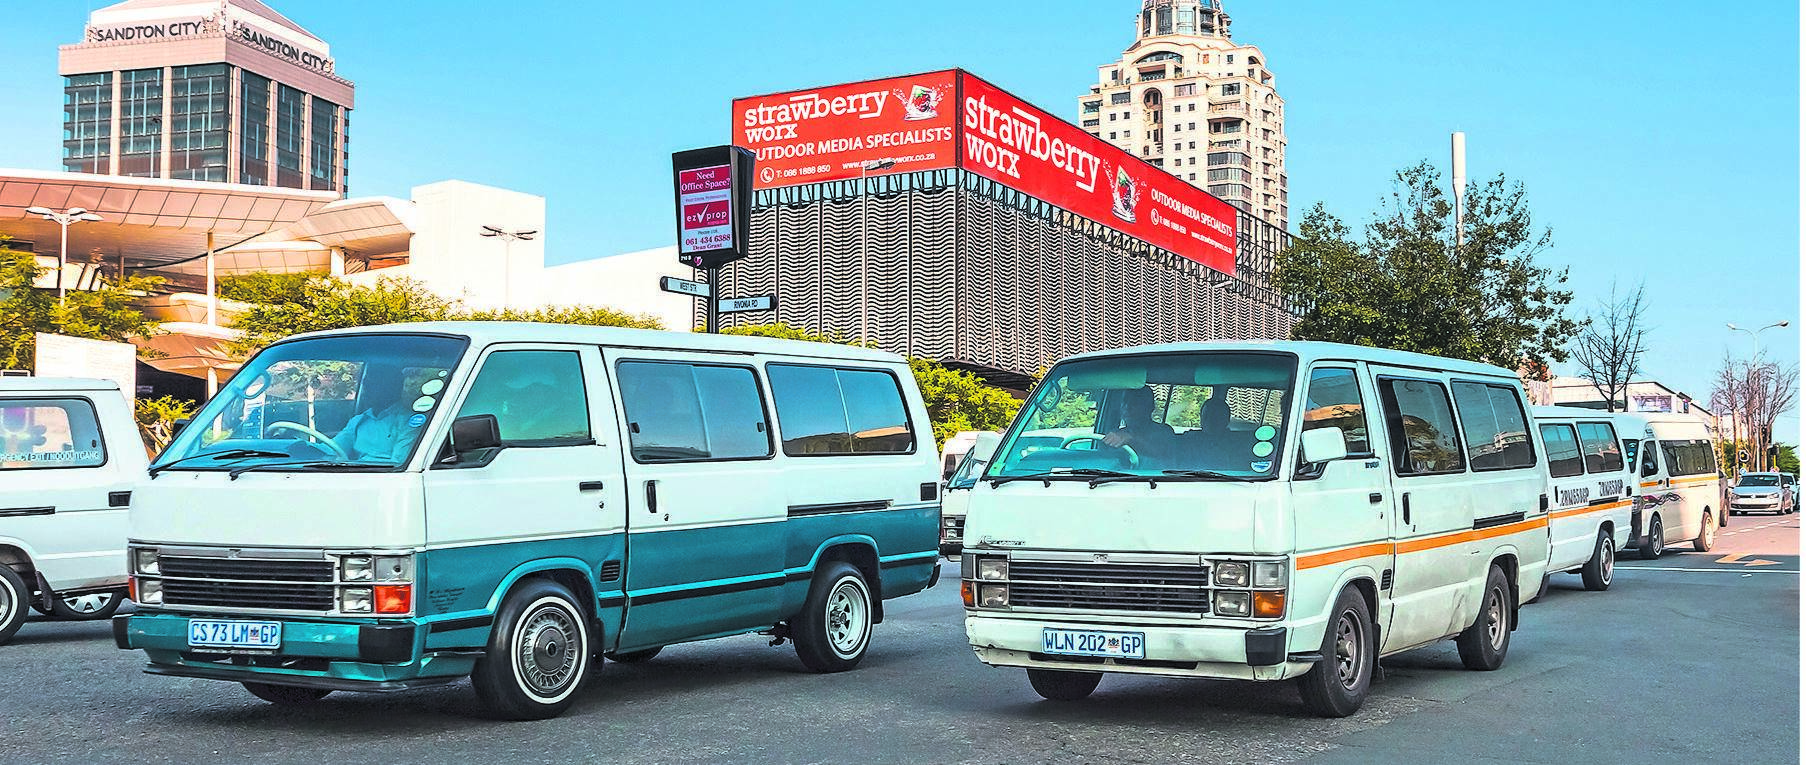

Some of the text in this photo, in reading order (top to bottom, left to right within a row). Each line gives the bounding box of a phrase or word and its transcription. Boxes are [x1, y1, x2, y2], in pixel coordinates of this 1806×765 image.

[97, 22, 202, 42] SANDTON CITY
[243, 28, 328, 71] SANDTON CITY
[744, 90, 889, 127] strawberry
[745, 123, 798, 143] worx
[817, 137, 863, 154] MEDIA
[866, 127, 952, 149] SPECIALISTS
[965, 95, 1101, 193] strawberry
[965, 132, 1021, 179] worx
[681, 177, 731, 192] Office Space?
[696, 170, 715, 180] Need
[776, 170, 783, 178] T:
[1151, 188, 1233, 238] OUTDOOR MEDIA SPECIALISTS
[734, 301, 751, 309] RIVONIA
[191, 623, 278, 643] CS 73 LM GP
[1045, 632, 1141, 654] WLN 202 GP
